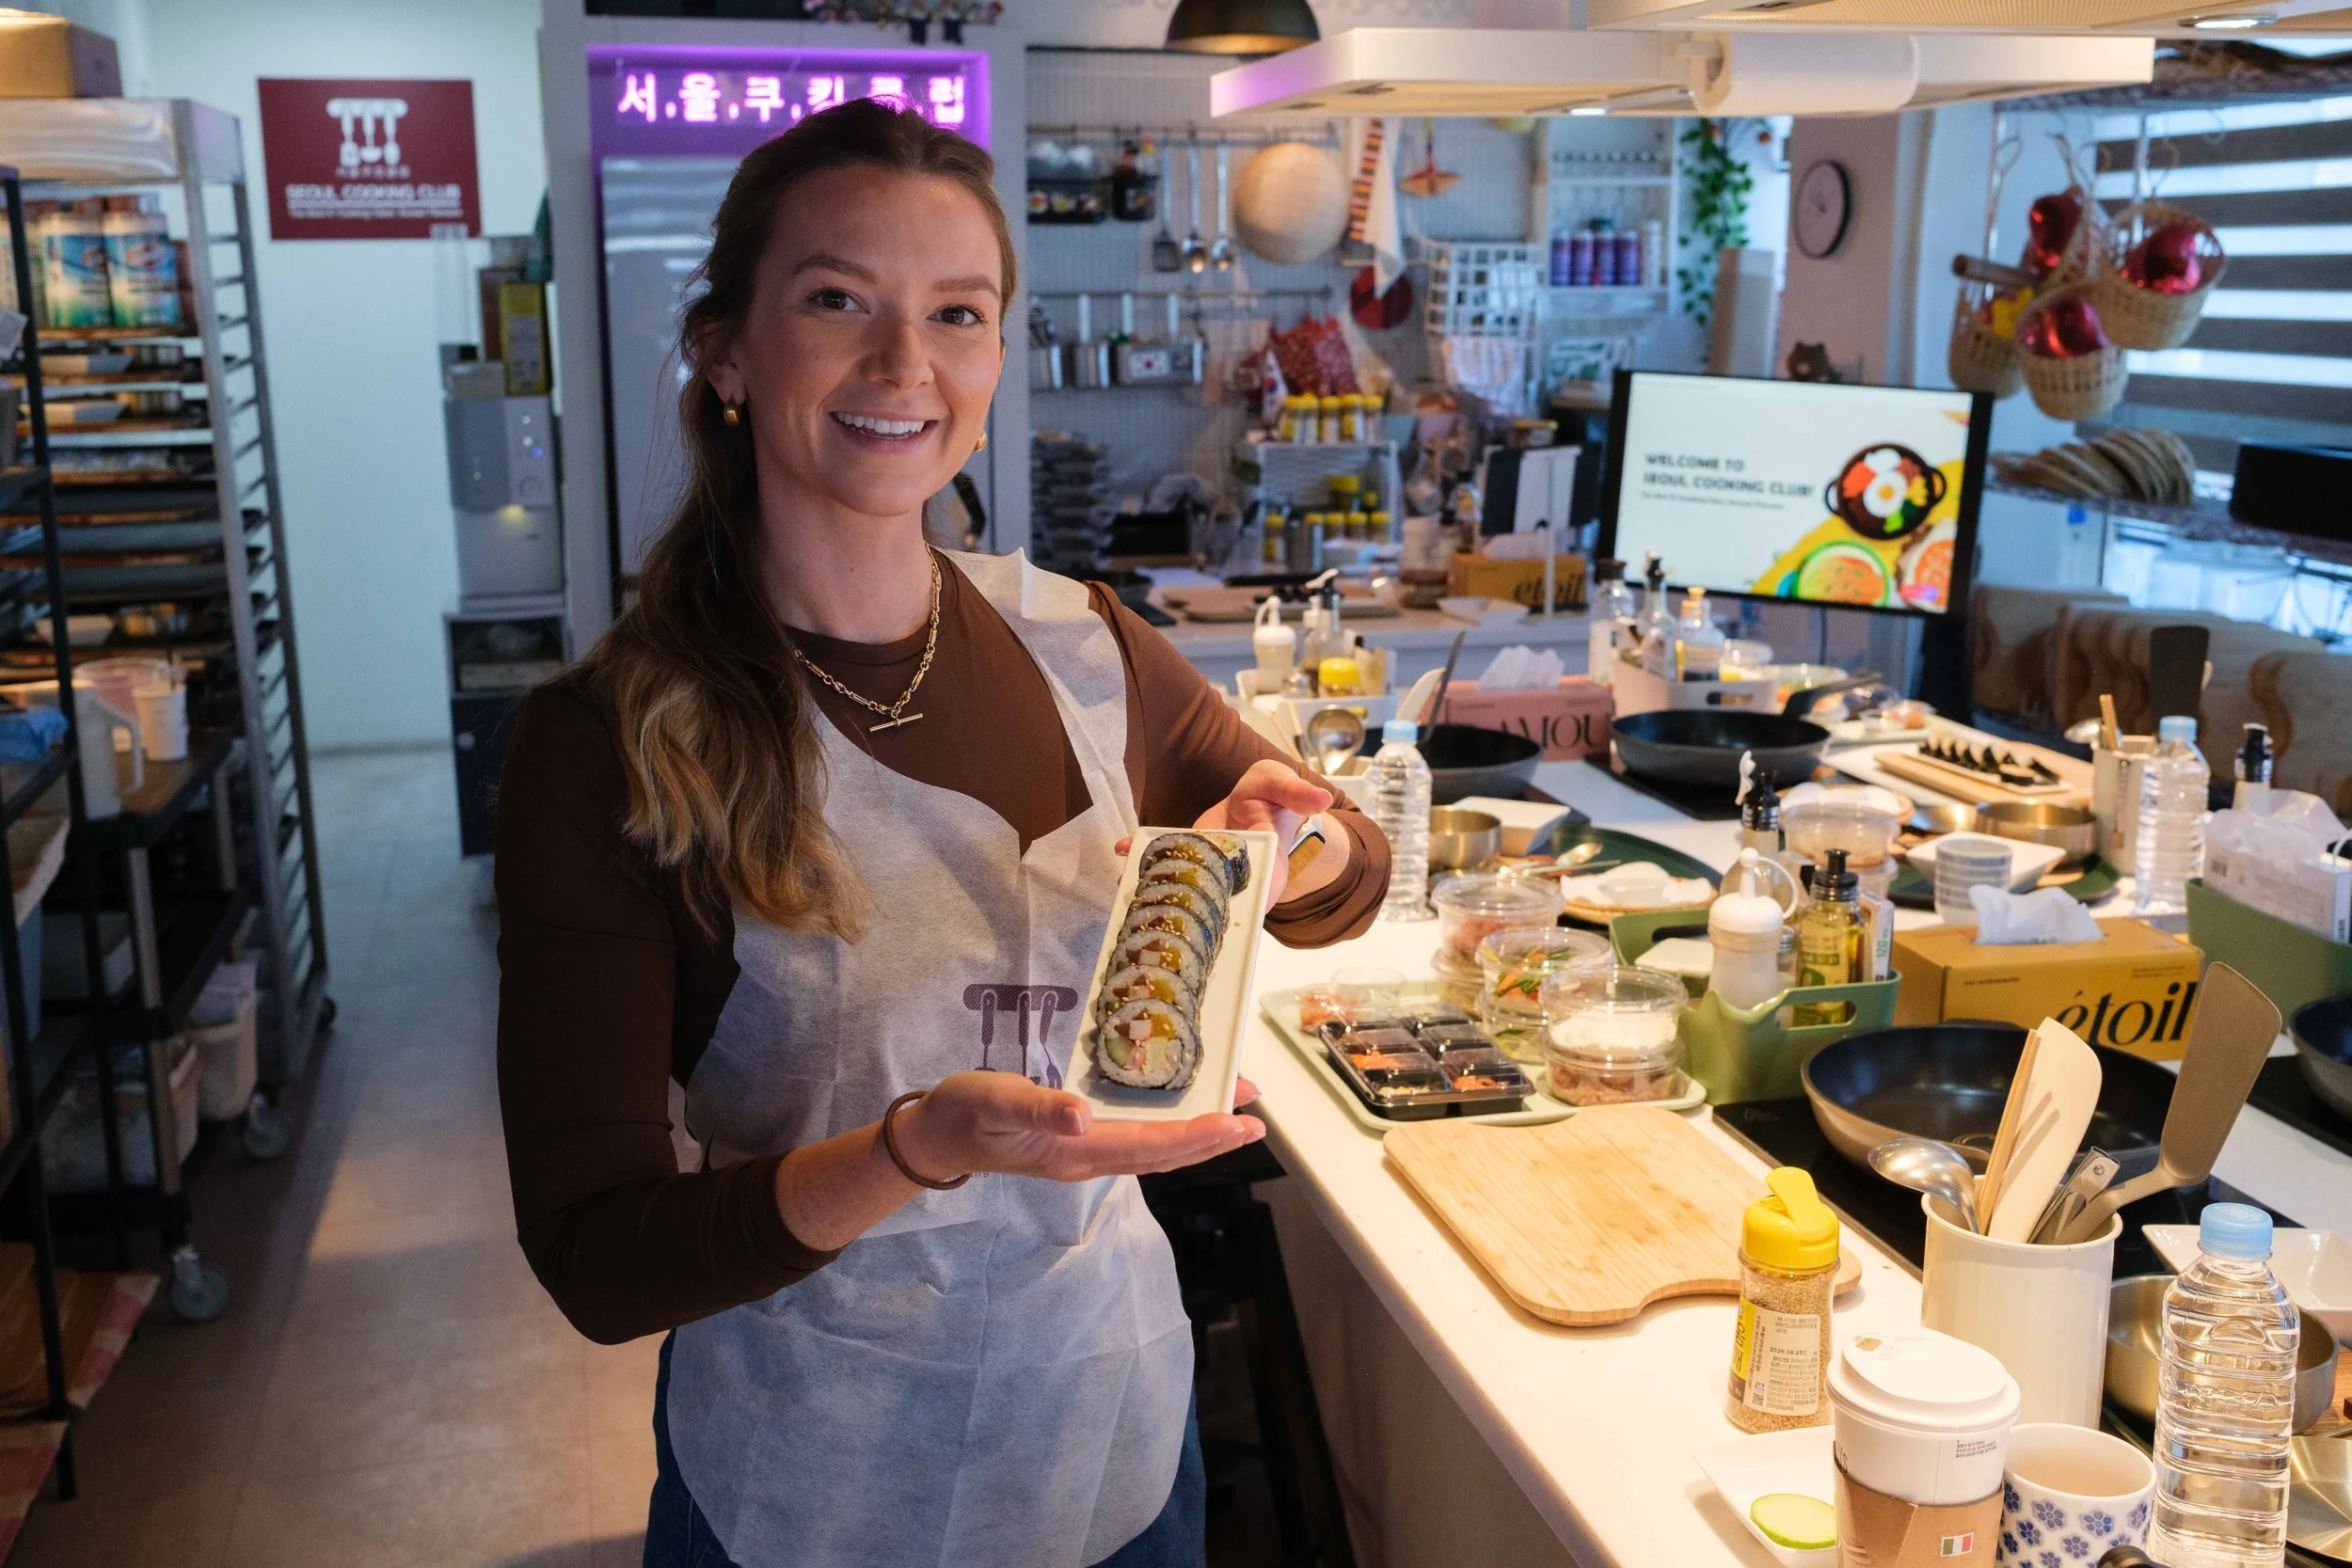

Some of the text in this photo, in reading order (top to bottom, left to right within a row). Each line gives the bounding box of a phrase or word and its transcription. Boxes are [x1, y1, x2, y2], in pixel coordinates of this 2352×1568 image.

[1645, 452, 1746, 471] WELCOME TO
[1644, 472, 1688, 488] SEOUL
[1692, 475, 1765, 494] COOKING
